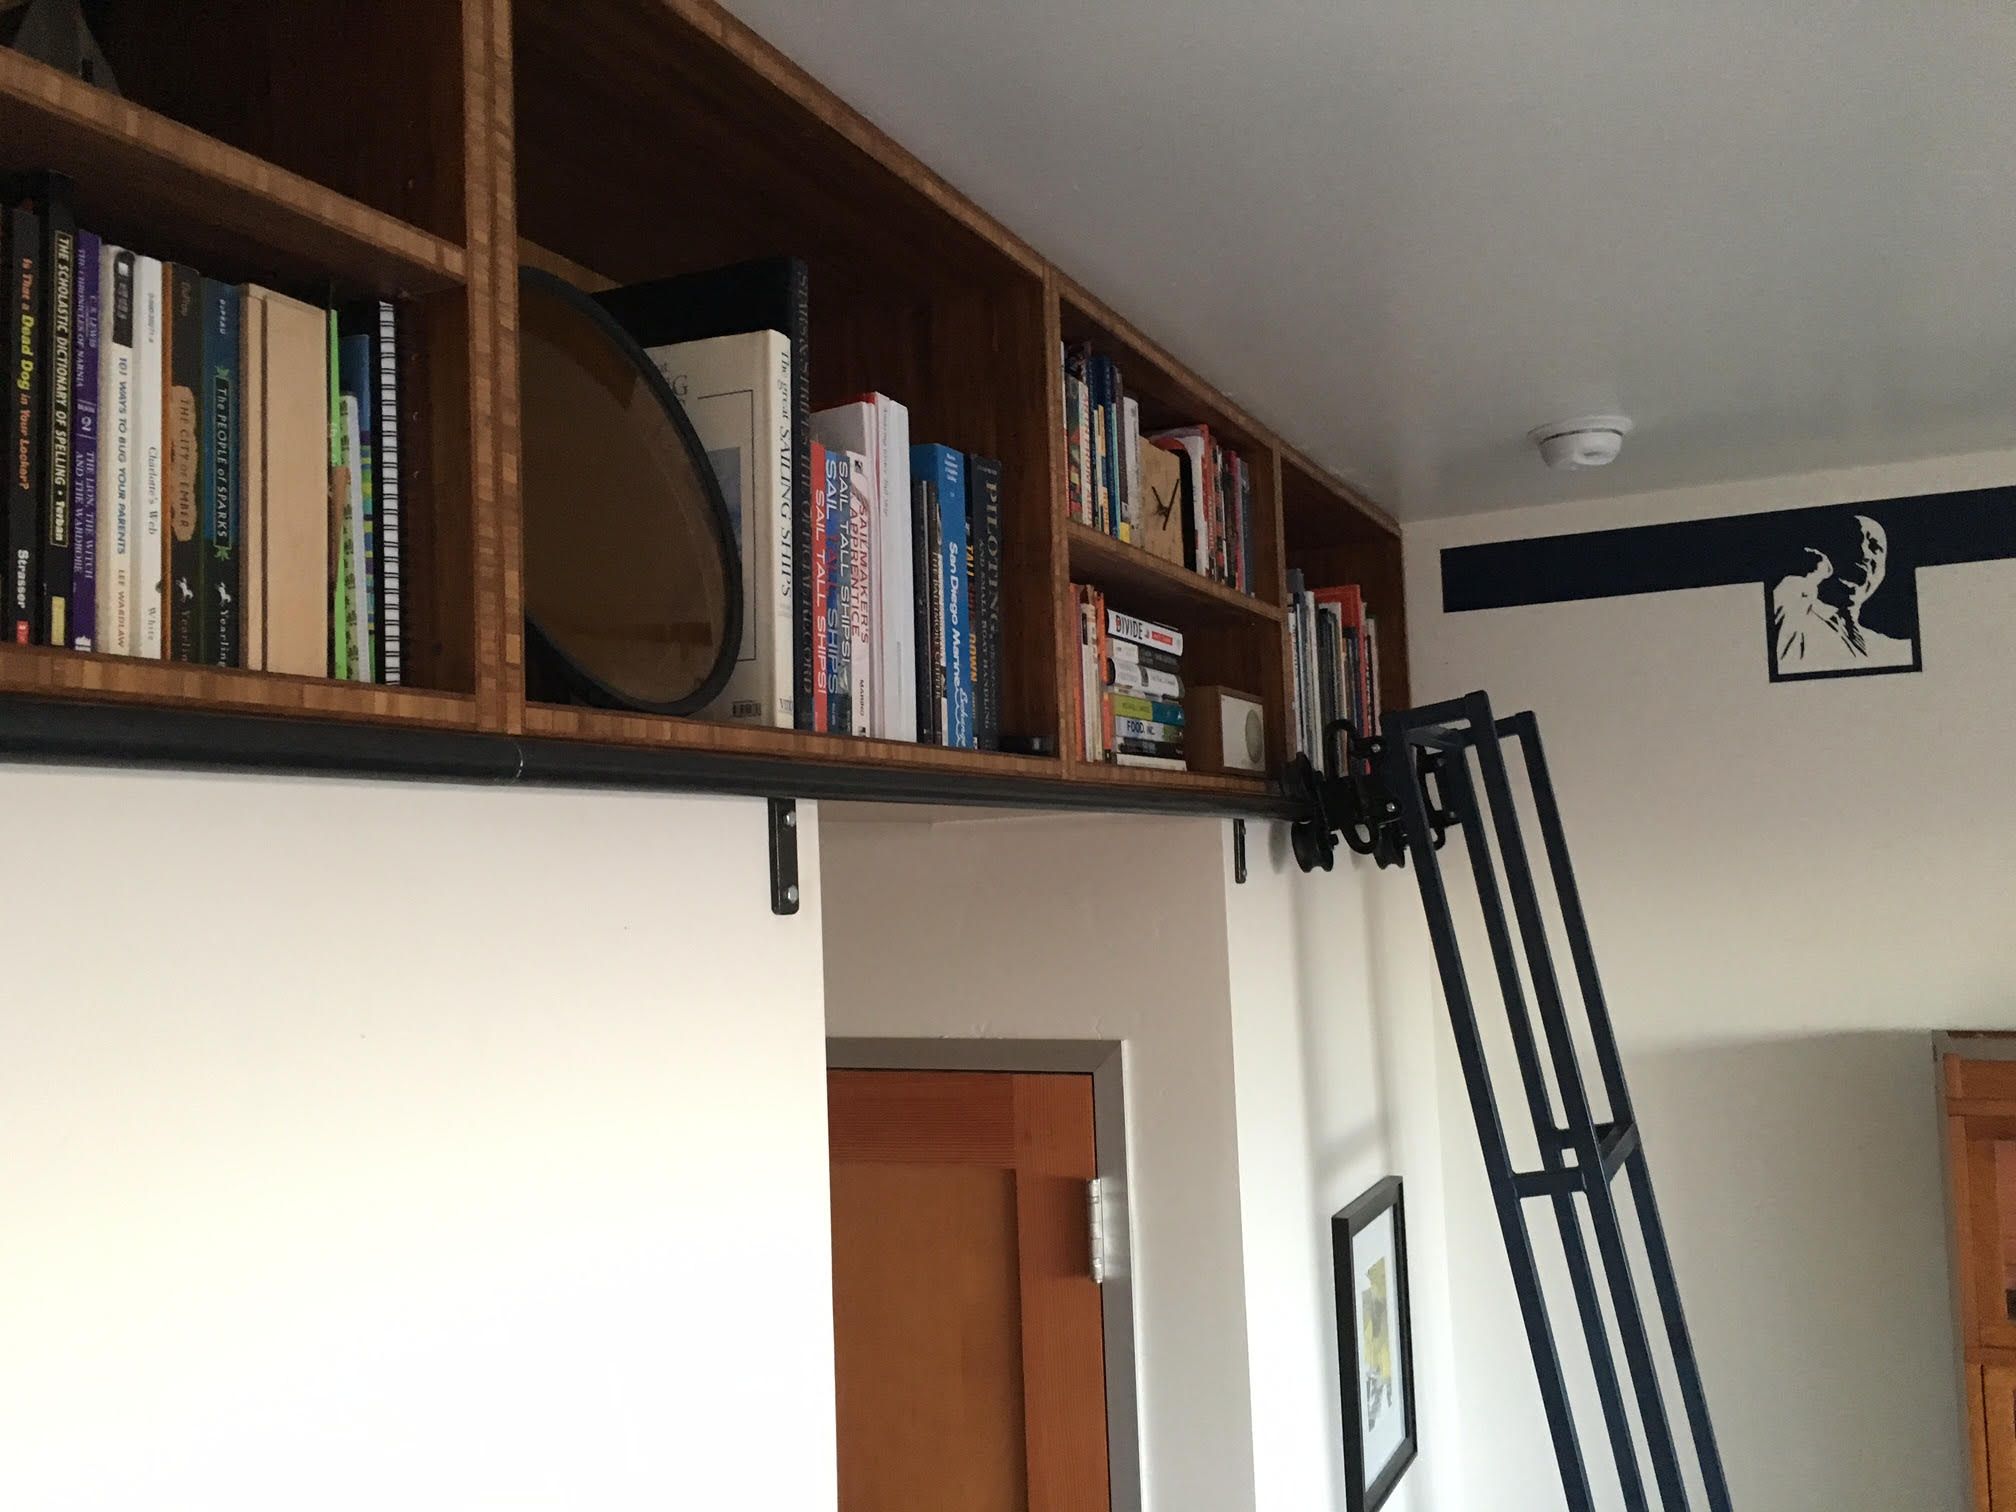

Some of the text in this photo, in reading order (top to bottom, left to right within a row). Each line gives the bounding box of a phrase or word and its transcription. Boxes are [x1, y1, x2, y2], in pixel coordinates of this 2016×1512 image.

[21, 274, 33, 300] That
[21, 314, 34, 356] Dead
[75, 248, 86, 388] THE CHRONICLES OF NARNIA
[87, 316, 97, 348] LEWIS
[17, 360, 34, 391] Dog
[20, 393, 31, 405] in
[54, 236, 70, 541] THE SCHOLASTIC DICTIONARY OF SPELLING Terban
[217, 387, 228, 410] The
[19, 408, 31, 436] Your
[81, 415, 92, 432] 2
[180, 399, 190, 422] THE
[18, 437, 30, 490] Locker?
[75, 452, 84, 475] AND
[85, 451, 95, 471] THE
[117, 357, 128, 555] 101 WAYS TO BUG YOUR PARENTS
[180, 428, 190, 460] CITY
[217, 414, 229, 465] PEOPLE
[75, 479, 83, 503] THE
[148, 446, 158, 536] Charlotte's Web
[777, 351, 793, 597] The great SAILING SHIPS
[825, 458, 838, 520] SAIL
[85, 511, 93, 531] THE
[179, 482, 190, 528] EMBER
[217, 486, 228, 538] SPARKS
[73, 507, 83, 573] WARDROBE
[84, 535, 93, 579] WITCH
[839, 460, 851, 663] SAIL TALL SHIPS!
[966, 544, 975, 577] TALL
[16, 549, 30, 610] Strasser
[815, 490, 827, 694] SAIL TALL SHIPS!
[850, 506, 860, 637] APPRENTICE
[857, 503, 869, 644] SAILMAKER'S
[117, 569, 126, 648] LEE WARDLAW
[147, 607, 157, 641] White
[950, 576, 959, 625] Diego
[180, 609, 191, 662] Yearlin
[803, 598, 813, 694] RECORD
[827, 607, 838, 694] SHIPS
[978, 538, 986, 568] AND
[983, 659, 991, 730] HANDLING
[1115, 614, 1143, 640] DIVIDE
[951, 628, 962, 688] Marine
[969, 633, 978, 683] DOWN
